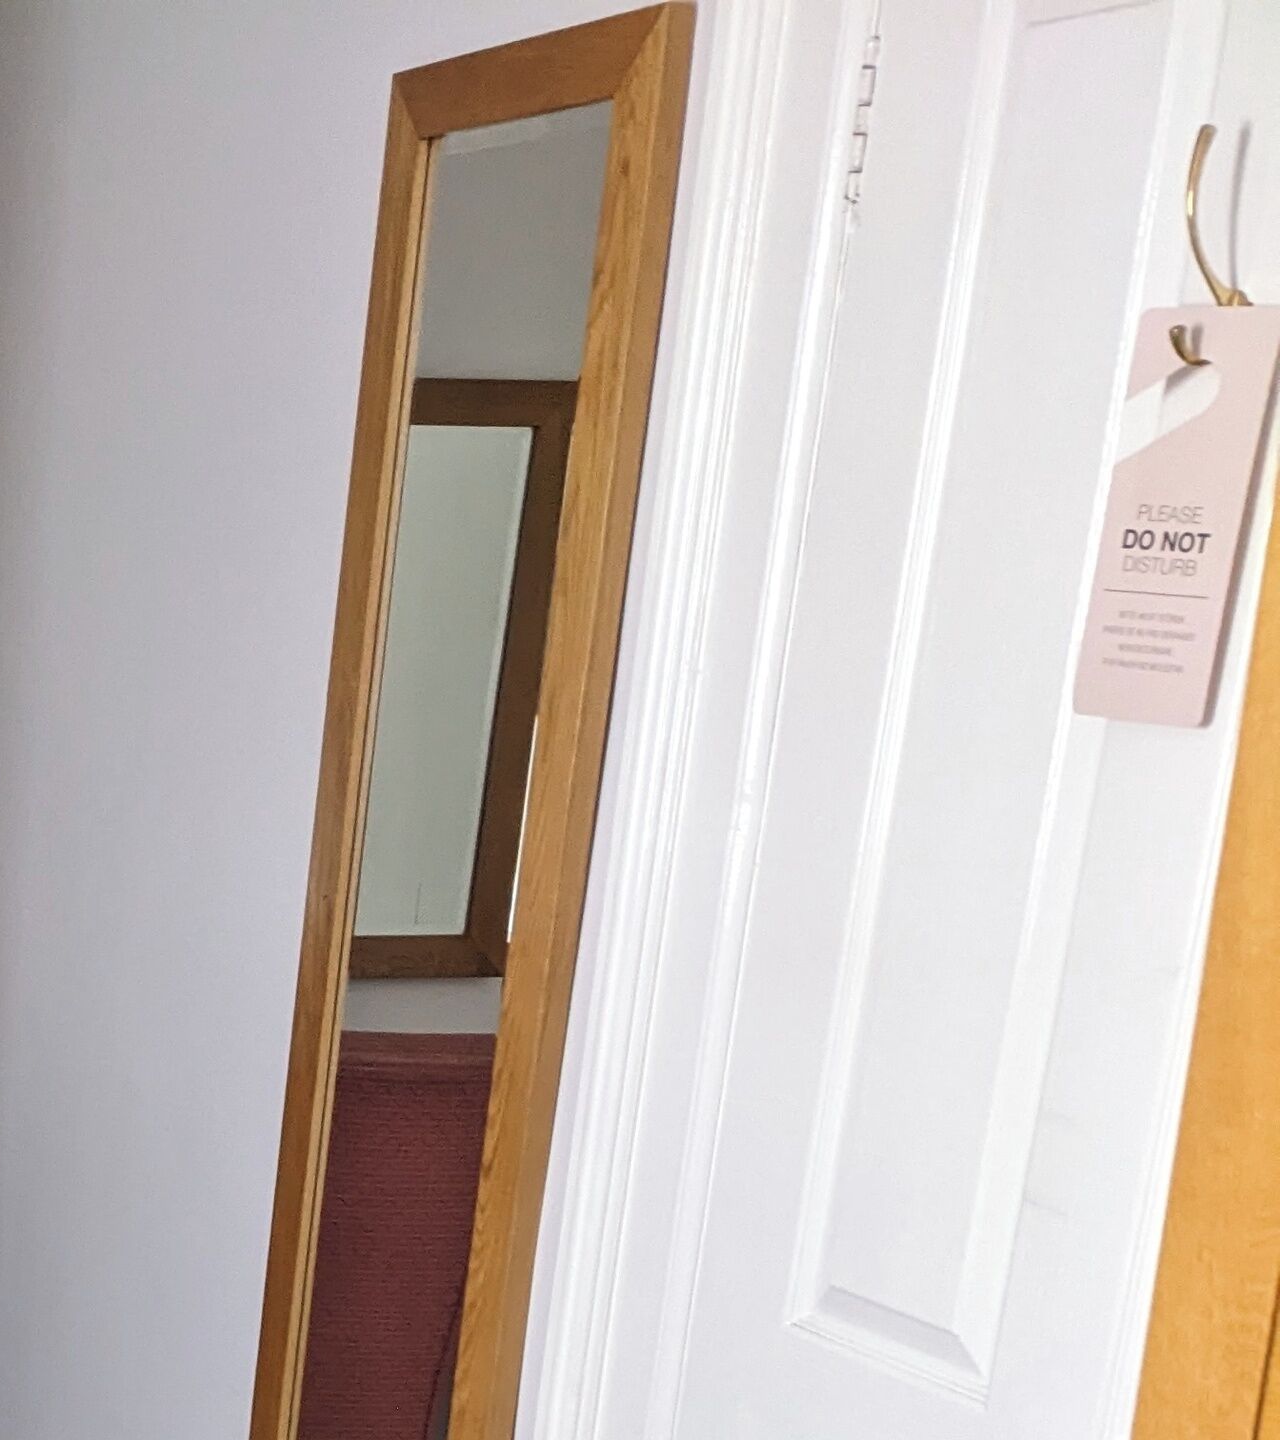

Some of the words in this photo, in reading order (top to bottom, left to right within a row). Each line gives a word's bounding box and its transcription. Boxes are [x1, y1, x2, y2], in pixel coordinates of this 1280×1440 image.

[1137, 504, 1204, 524] PLEASE
[1122, 528, 1155, 550] DO
[1160, 530, 1212, 554] NOT
[1122, 555, 1198, 576] DISTURB
